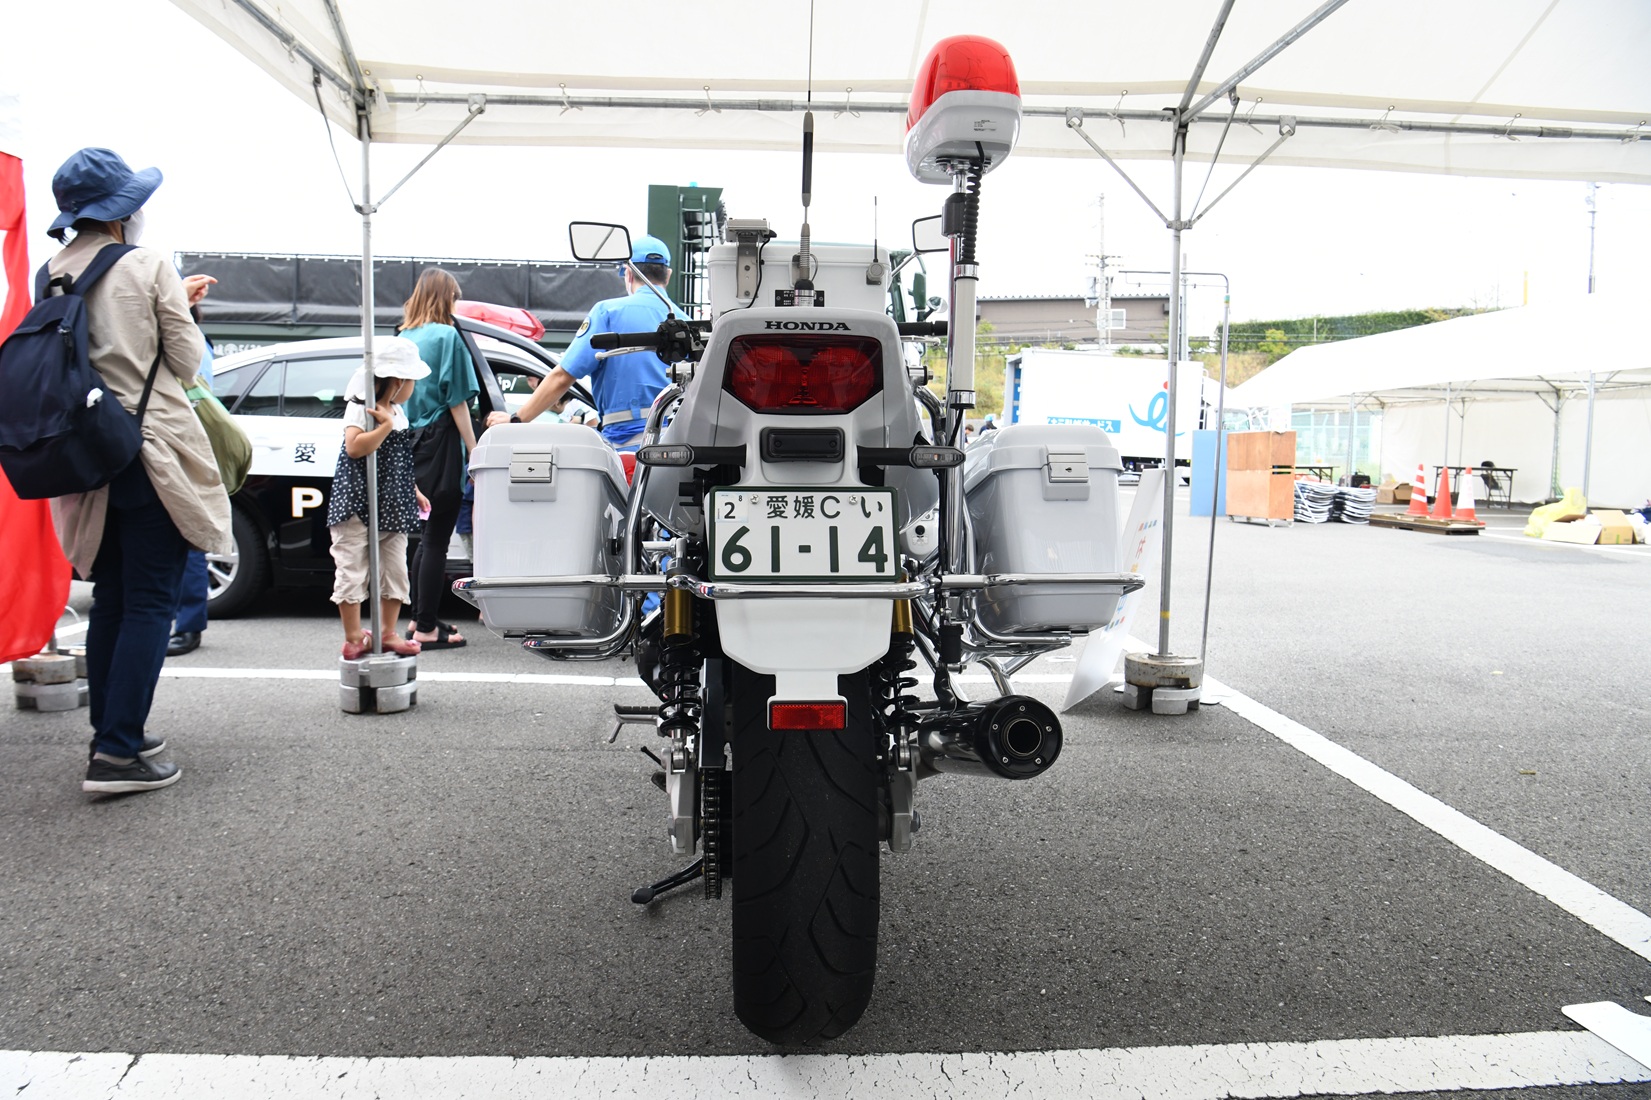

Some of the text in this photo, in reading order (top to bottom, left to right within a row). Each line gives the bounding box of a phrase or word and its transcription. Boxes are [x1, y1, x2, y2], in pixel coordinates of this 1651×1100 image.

[764, 320, 851, 331] HONDA
[291, 487, 324, 517] P
[724, 502, 736, 519] 2
[721, 525, 888, 573] 61-14
